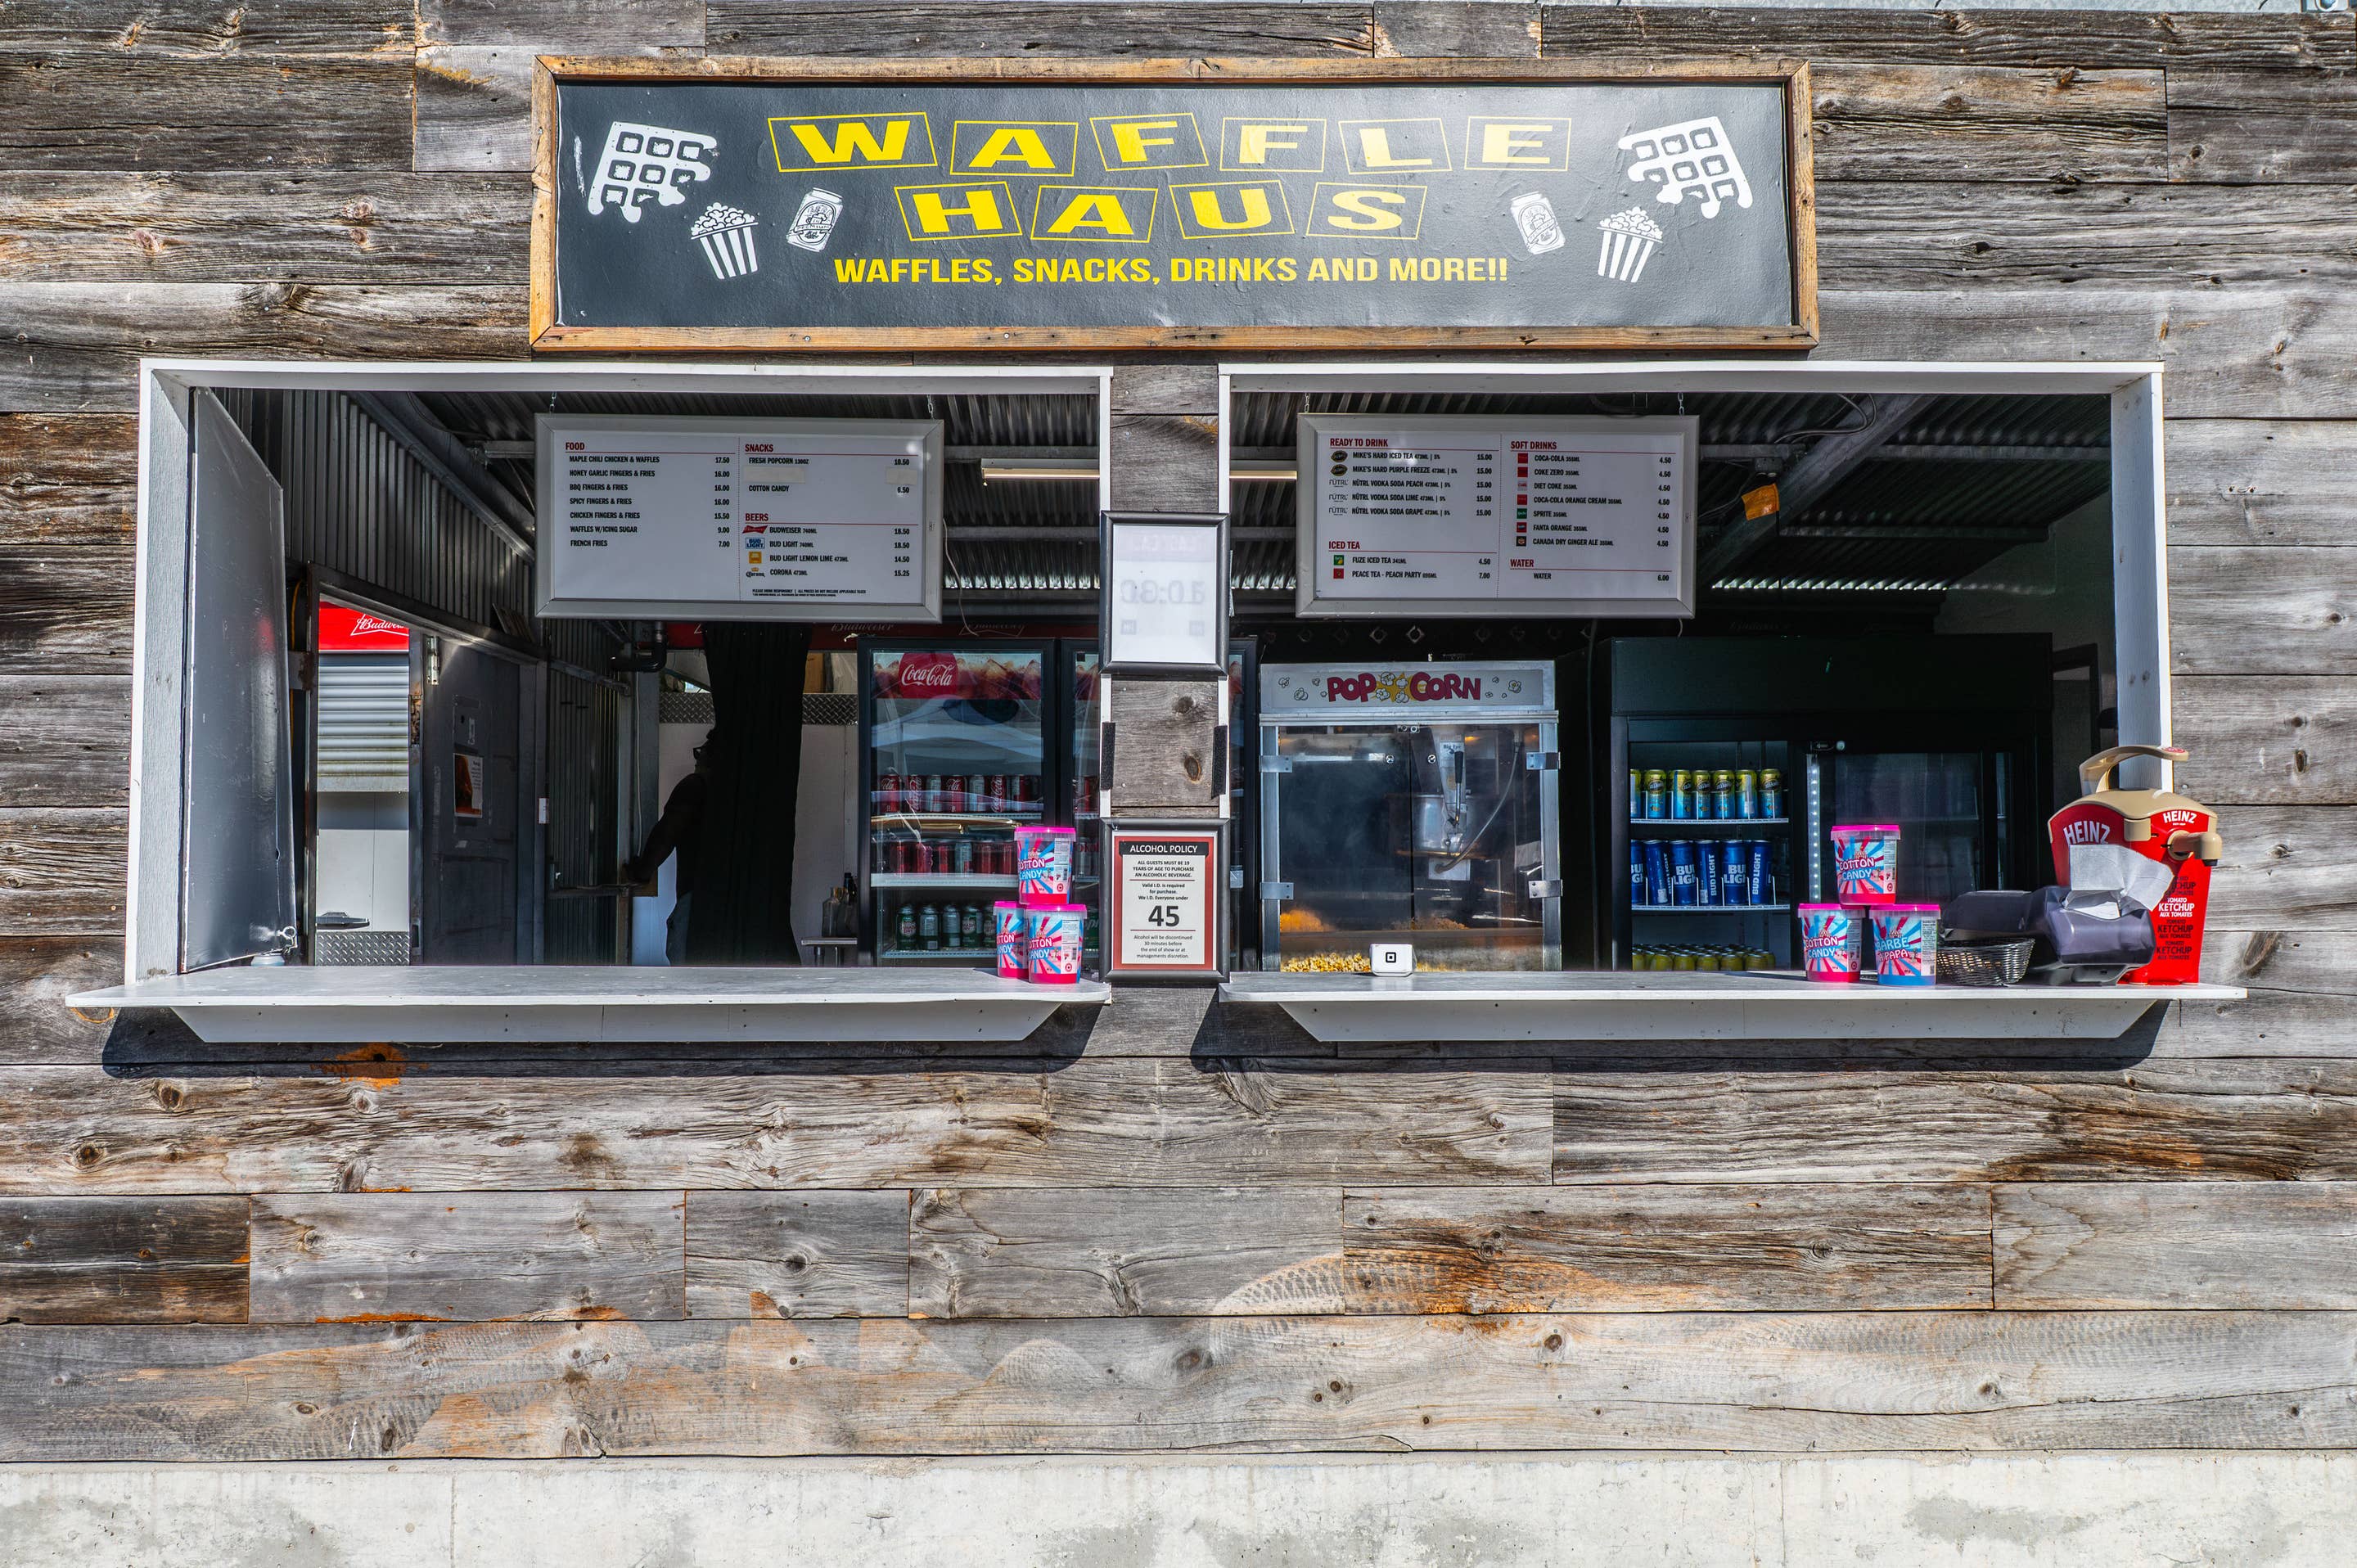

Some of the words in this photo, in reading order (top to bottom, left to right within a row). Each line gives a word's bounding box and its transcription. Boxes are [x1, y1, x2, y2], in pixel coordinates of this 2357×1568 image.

[790, 120, 1553, 169] WAFFLE
[913, 189, 1406, 235] HAUS
[834, 258, 1003, 286] WAFFLES,
[1013, 258, 1160, 286] SNACKS,
[1170, 257, 1297, 282] DRINKS
[1308, 257, 1379, 282] AND
[1389, 257, 1508, 282] MORE!!
[566, 442, 585, 451] FOOD
[745, 444, 773, 453] SNACKS
[1330, 438, 1354, 447] READY
[1354, 438, 1363, 447] TO
[1365, 439, 1389, 447] DRINK
[1511, 441, 1529, 449] SOFT
[1530, 441, 1557, 450] DRINKS
[745, 513, 768, 522] BEERS
[594, 525, 618, 534] W/ICING
[1328, 541, 1345, 549] ICED
[1346, 541, 1360, 549] TEA
[1510, 559, 1535, 567] WATER
[901, 663, 956, 687] Coca-Cola
[1327, 673, 1377, 702] POP
[1409, 671, 1481, 702] CORN
[2163, 810, 2197, 823] HEINZ
[2063, 820, 2111, 845] HEINZ
[1129, 845, 1168, 853] ALCOHOL
[1169, 845, 1197, 854] POLICY
[1753, 852, 1761, 878] LIGHT
[1839, 858, 1874, 871] COTTON
[1842, 869, 1872, 880] CANDY
[2158, 903, 2195, 912] KETCHUP
[1148, 905, 1180, 927] 45
[1877, 937, 1909, 950] BARBE
